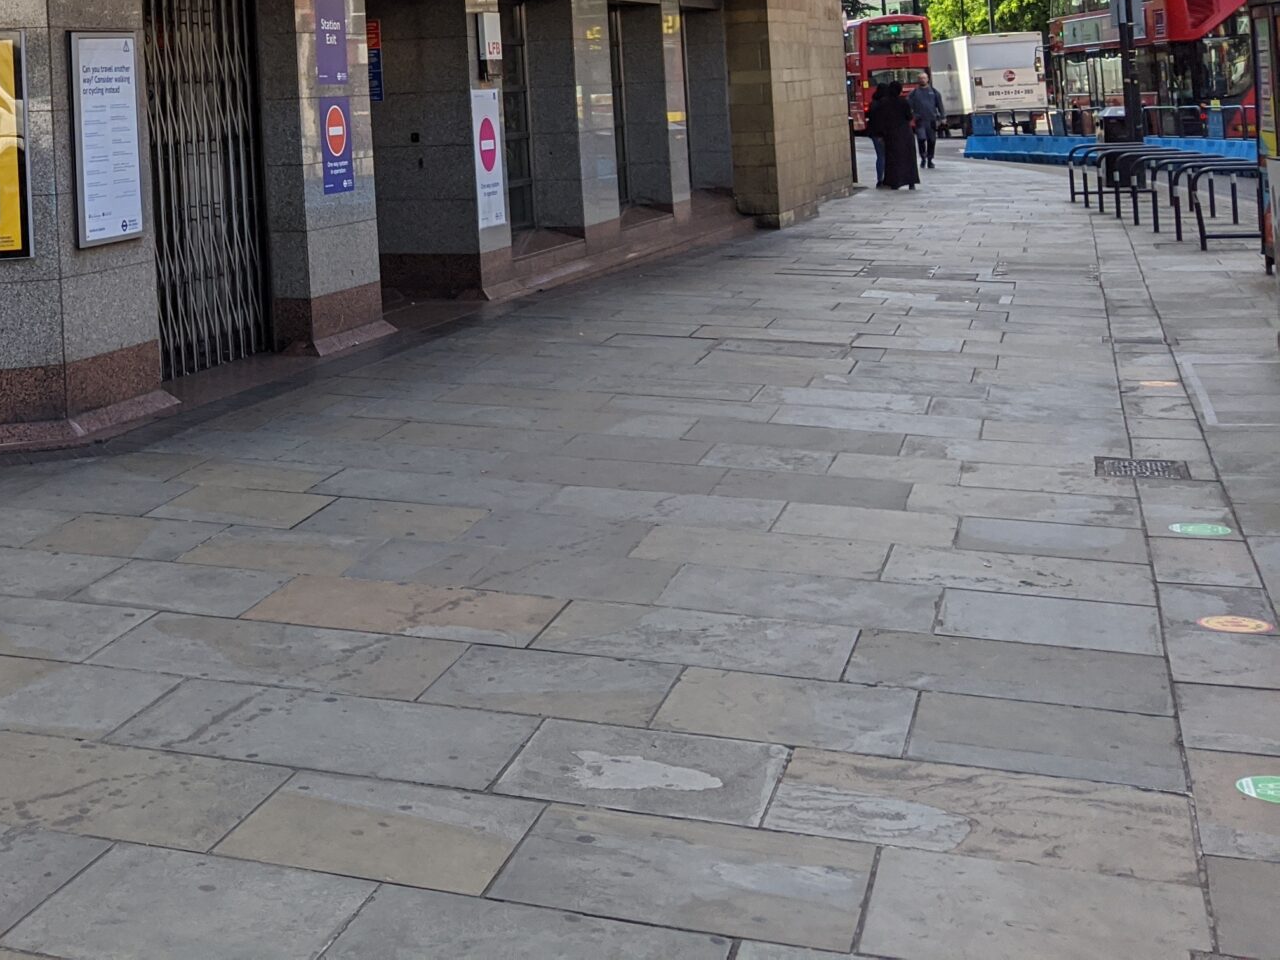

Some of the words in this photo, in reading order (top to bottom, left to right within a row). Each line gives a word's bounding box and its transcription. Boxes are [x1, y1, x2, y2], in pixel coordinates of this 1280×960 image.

[321, 19, 341, 30] Station
[326, 33, 337, 45] Exit
[488, 42, 500, 55] LFB
